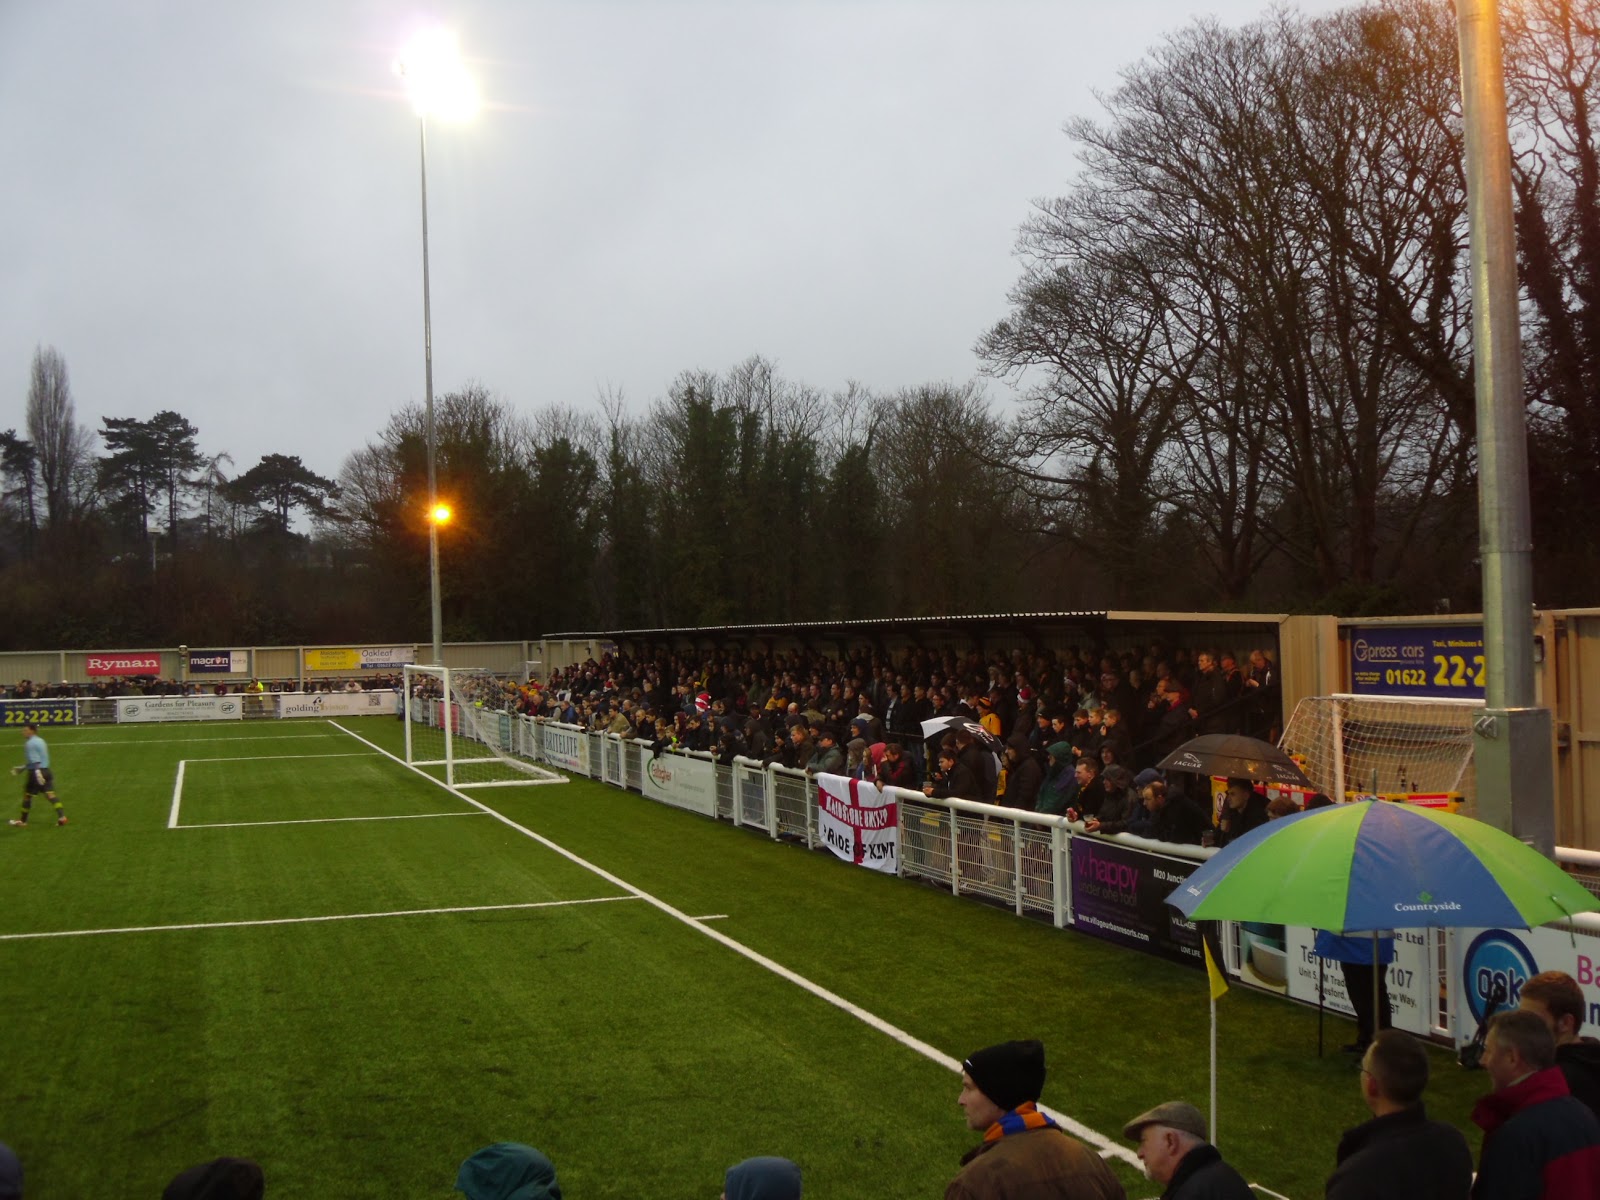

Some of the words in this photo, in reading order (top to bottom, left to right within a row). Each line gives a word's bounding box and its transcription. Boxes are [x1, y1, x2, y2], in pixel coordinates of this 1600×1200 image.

[361, 649, 393, 658] Oakleaf
[1401, 645, 1424, 658] cars
[88, 658, 158, 671] Ryman
[190, 656, 229, 665] macron
[1386, 668, 1427, 685] 01622
[145, 700, 174, 708] Gardens
[187, 699, 215, 707] Pleasure
[286, 704, 320, 714] golding
[545, 731, 579, 758] BRITELITE
[1173, 760, 1202, 769] JAGUAR
[1077, 848, 1139, 895] v.happy
[1153, 868, 1166, 880] M20
[1394, 901, 1462, 913] Countryside
[1078, 913, 1150, 942] www.villageurbanresorts.com
[1171, 916, 1197, 930] VILLAGE
[1406, 932, 1424, 946] Ltd
[1180, 946, 1191, 955] LOVE
[1298, 967, 1311, 979] Unit
[1330, 975, 1346, 988] Trad
